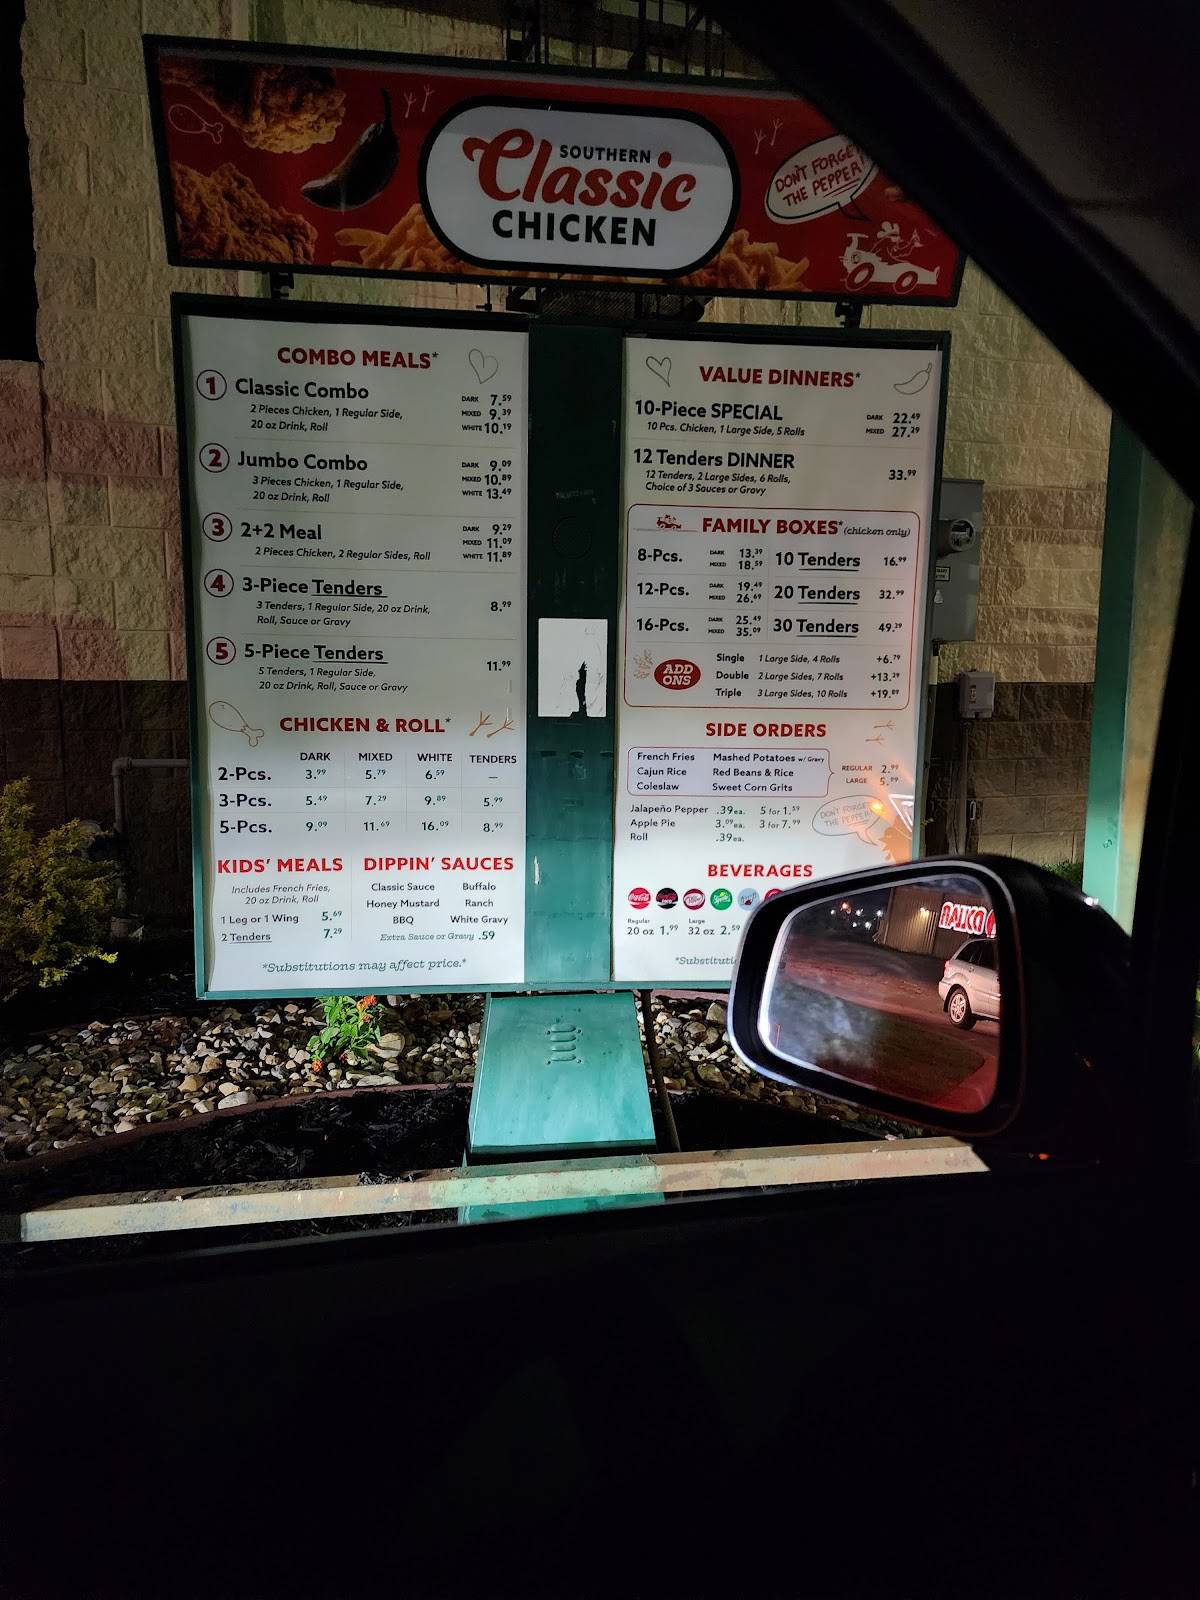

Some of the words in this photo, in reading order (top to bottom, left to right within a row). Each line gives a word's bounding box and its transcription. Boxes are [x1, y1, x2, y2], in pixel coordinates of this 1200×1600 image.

[560, 144, 651, 163] SOUTHERN
[462, 128, 696, 212] Classic
[782, 186, 809, 207] THE
[492, 209, 656, 246] CHICKEN
[277, 347, 356, 366] COMBO
[699, 366, 762, 384] VALUE
[206, 376, 216, 395] 1
[235, 378, 299, 397] Classic
[304, 381, 369, 399] Combo
[490, 394, 512, 406] 7.59
[250, 404, 257, 413] 2
[258, 404, 290, 415] Pieces
[292, 406, 332, 417] Chicken,
[336, 408, 339, 416] 1
[342, 408, 379, 419] Regular
[380, 409, 402, 420] Side,
[489, 408, 511, 420] 9.39
[635, 400, 707, 418] 10-Piece
[711, 403, 783, 421] SPECIAL
[893, 412, 920, 424] 22.49
[251, 419, 263, 429] 20
[265, 422, 277, 430] oz
[279, 421, 307, 432] Drink,
[310, 422, 328, 431] Roll
[484, 422, 512, 434] 10.19
[209, 449, 222, 467] 2
[237, 451, 299, 469] Jumbo
[303, 454, 368, 471] Combo
[634, 448, 653, 464] 12
[656, 449, 723, 466] Tenders
[728, 452, 795, 469] DINNER
[490, 460, 512, 472] 9.09
[484, 474, 512, 486] 10.89
[889, 469, 917, 480] 33.99
[486, 488, 512, 499] 13.49
[212, 518, 224, 536] 3
[241, 522, 275, 538] 2+2
[280, 523, 322, 540] Meal
[492, 524, 512, 535] 9.29
[703, 517, 771, 534] FAMILY
[843, 526, 884, 535] (chicken
[886, 528, 911, 538] only)
[487, 537, 512, 549] 11.09
[487, 551, 512, 562] 11.89
[637, 548, 682, 562] 8-Pcs.
[775, 552, 794, 566] 10
[797, 552, 860, 567] Tenders
[884, 557, 907, 566] 16.99
[210, 574, 226, 592] 4
[242, 577, 308, 593] 3-Piece
[311, 579, 383, 596] Tenders
[637, 582, 689, 596] 12-Pcs.
[774, 585, 794, 599] 20
[797, 585, 860, 600] Tenders
[879, 589, 904, 599] 32.99
[490, 601, 512, 612] 8.99
[637, 618, 689, 632] 16-Pcs.
[773, 618, 792, 632] 30
[796, 618, 859, 633] Tenders
[216, 642, 228, 660] 5
[244, 643, 310, 659] 5-Piece
[313, 645, 384, 660] Tenders
[716, 653, 745, 664] Single
[487, 660, 511, 671] 11.99
[663, 663, 694, 676] ADD
[662, 673, 691, 687] ONS
[716, 670, 749, 679] Double
[715, 688, 742, 698] Triple
[280, 717, 369, 732] CHICKEN
[376, 718, 390, 732] &
[706, 723, 747, 736] SIDE
[753, 723, 826, 737] ORDERS
[300, 752, 330, 761] DARK
[358, 753, 393, 761] MIXED
[417, 753, 452, 762] WHITE
[470, 755, 517, 764] TENDERS
[637, 752, 669, 761] French
[672, 752, 695, 761] Fries
[713, 753, 750, 762] Mashed
[753, 753, 795, 762] Potatoes
[218, 767, 271, 780] 2-Pcs.
[305, 769, 326, 780] 3.99
[365, 769, 386, 780] 5.79
[425, 769, 445, 780] 6.59
[637, 767, 664, 778] Cajun
[667, 767, 687, 776] Rice
[713, 768, 731, 776] Red
[733, 768, 762, 776] Beans
[764, 768, 771, 776] &
[774, 768, 794, 777] Rice
[636, 782, 679, 790] Coleslaw
[712, 783, 741, 791] Sweet
[744, 783, 767, 791] Corn
[769, 783, 792, 792] Grits
[219, 793, 272, 807] 3-Pcs.
[306, 795, 327, 806] 5.49
[365, 795, 387, 805] 7.29
[484, 797, 503, 807] 5.99
[630, 804, 672, 814] Jalapeño
[675, 805, 708, 815] Pepper
[220, 820, 272, 834] 5-Pcs.
[306, 821, 327, 831] 9.09
[483, 823, 503, 832] 8.99
[630, 818, 658, 828] Apple
[661, 819, 675, 827] Pie
[218, 858, 270, 873] KIDS'
[277, 858, 343, 872] MEALS
[364, 857, 435, 871] DIPPIN'
[441, 857, 513, 870] SAUCES
[708, 864, 812, 877] BEVERAGES
[371, 883, 404, 891] Classic
[407, 882, 435, 891] Sauce
[463, 882, 496, 890] Buffalo
[367, 900, 398, 909] Honey
[400, 899, 439, 907] Mustard
[465, 898, 493, 907] Ranch
[221, 916, 225, 924] 1
[229, 916, 247, 925] Leg
[264, 914, 268, 923] 1
[272, 914, 299, 924] Wing
[393, 916, 414, 925] BBQ
[450, 915, 478, 923] White
[481, 915, 508, 925] Gravy
[222, 933, 227, 941] 2
[229, 932, 272, 943] Tenders
[323, 928, 342, 938] 7.29
[358, 962, 386, 972] may
[389, 959, 425, 972] affect
